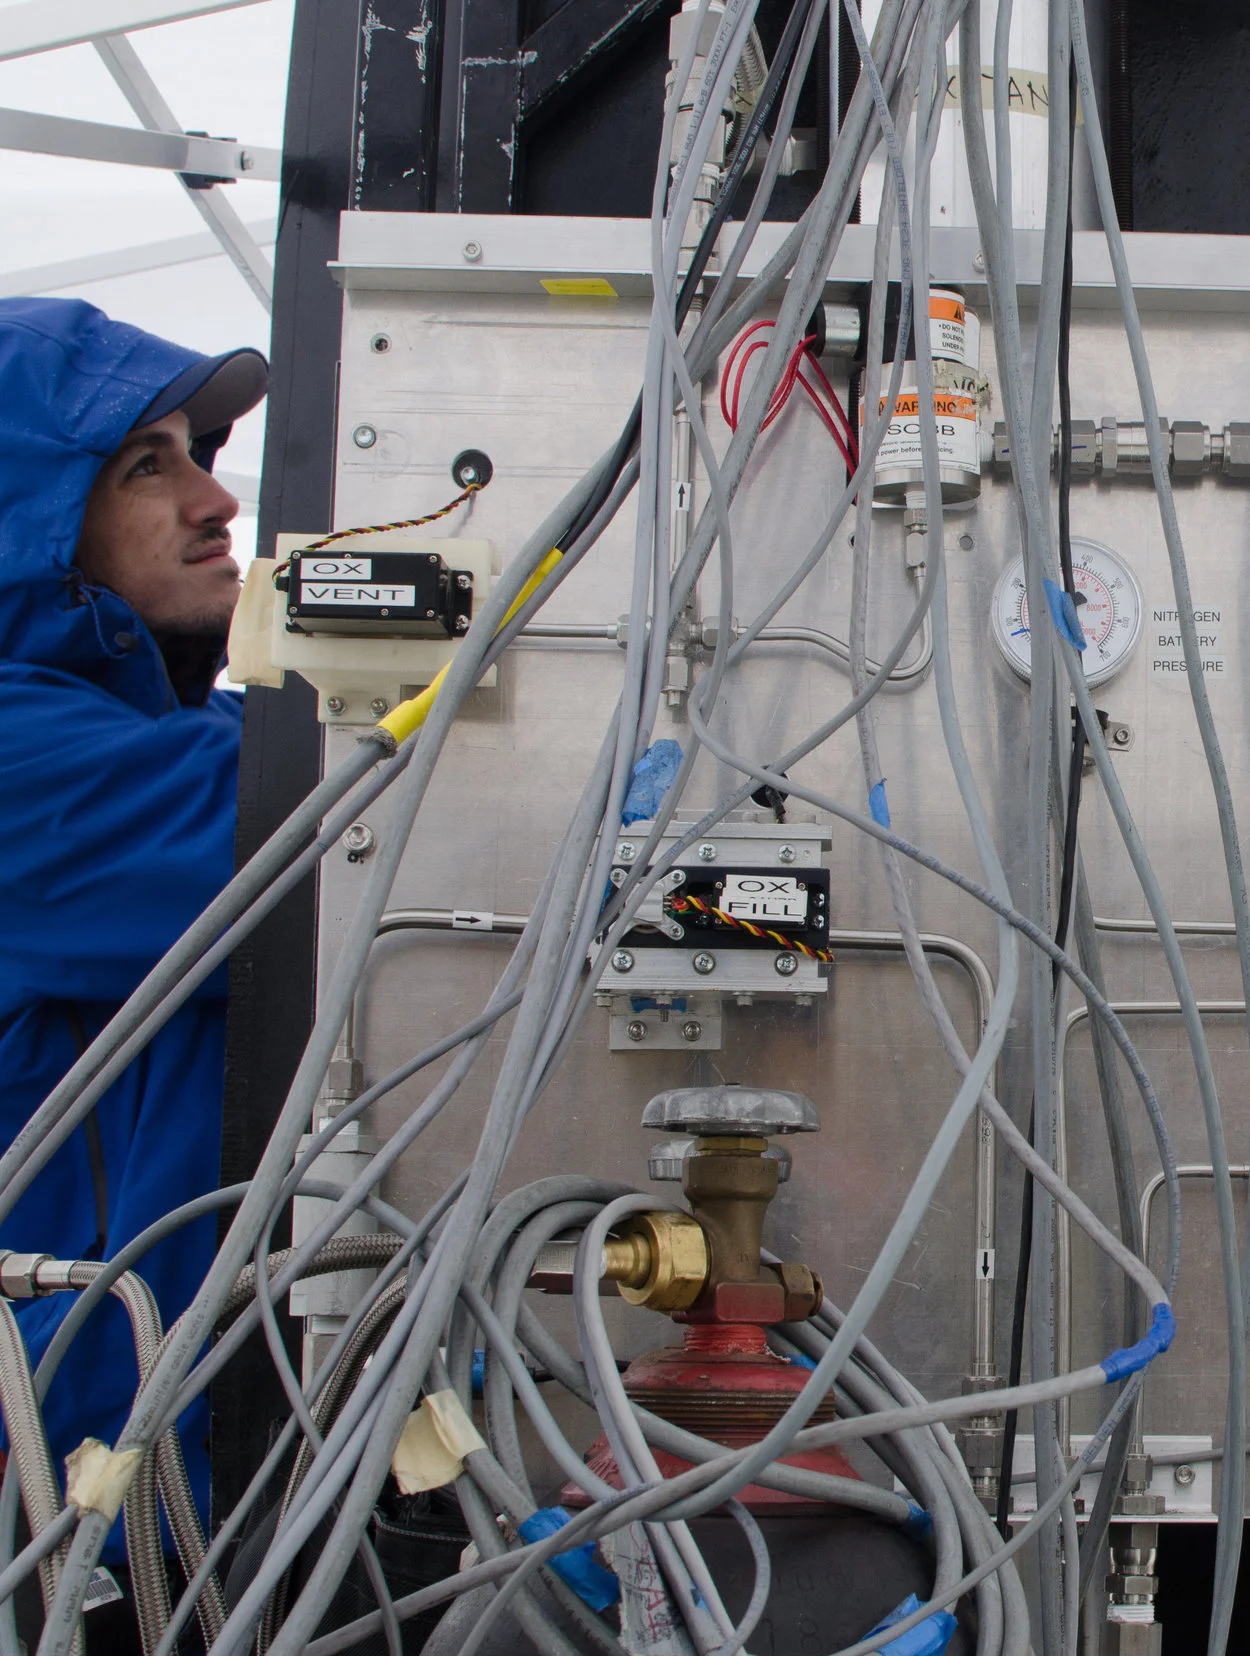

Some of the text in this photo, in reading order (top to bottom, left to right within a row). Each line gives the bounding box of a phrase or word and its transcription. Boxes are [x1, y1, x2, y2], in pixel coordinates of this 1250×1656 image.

[892, 400, 959, 414] WARING
[1080, 553, 1094, 564] 400
[312, 562, 364, 575] OX
[1112, 577, 1125, 590] 500
[307, 587, 406, 601] VENT
[1120, 616, 1131, 629] 600
[1153, 611, 1221, 622] NITRGEN
[1158, 635, 1217, 647] BATRY
[1098, 651, 1112, 662] 700
[1153, 660, 1224, 672] PRESURE
[737, 879, 791, 895] OX
[727, 901, 803, 917] FILL
